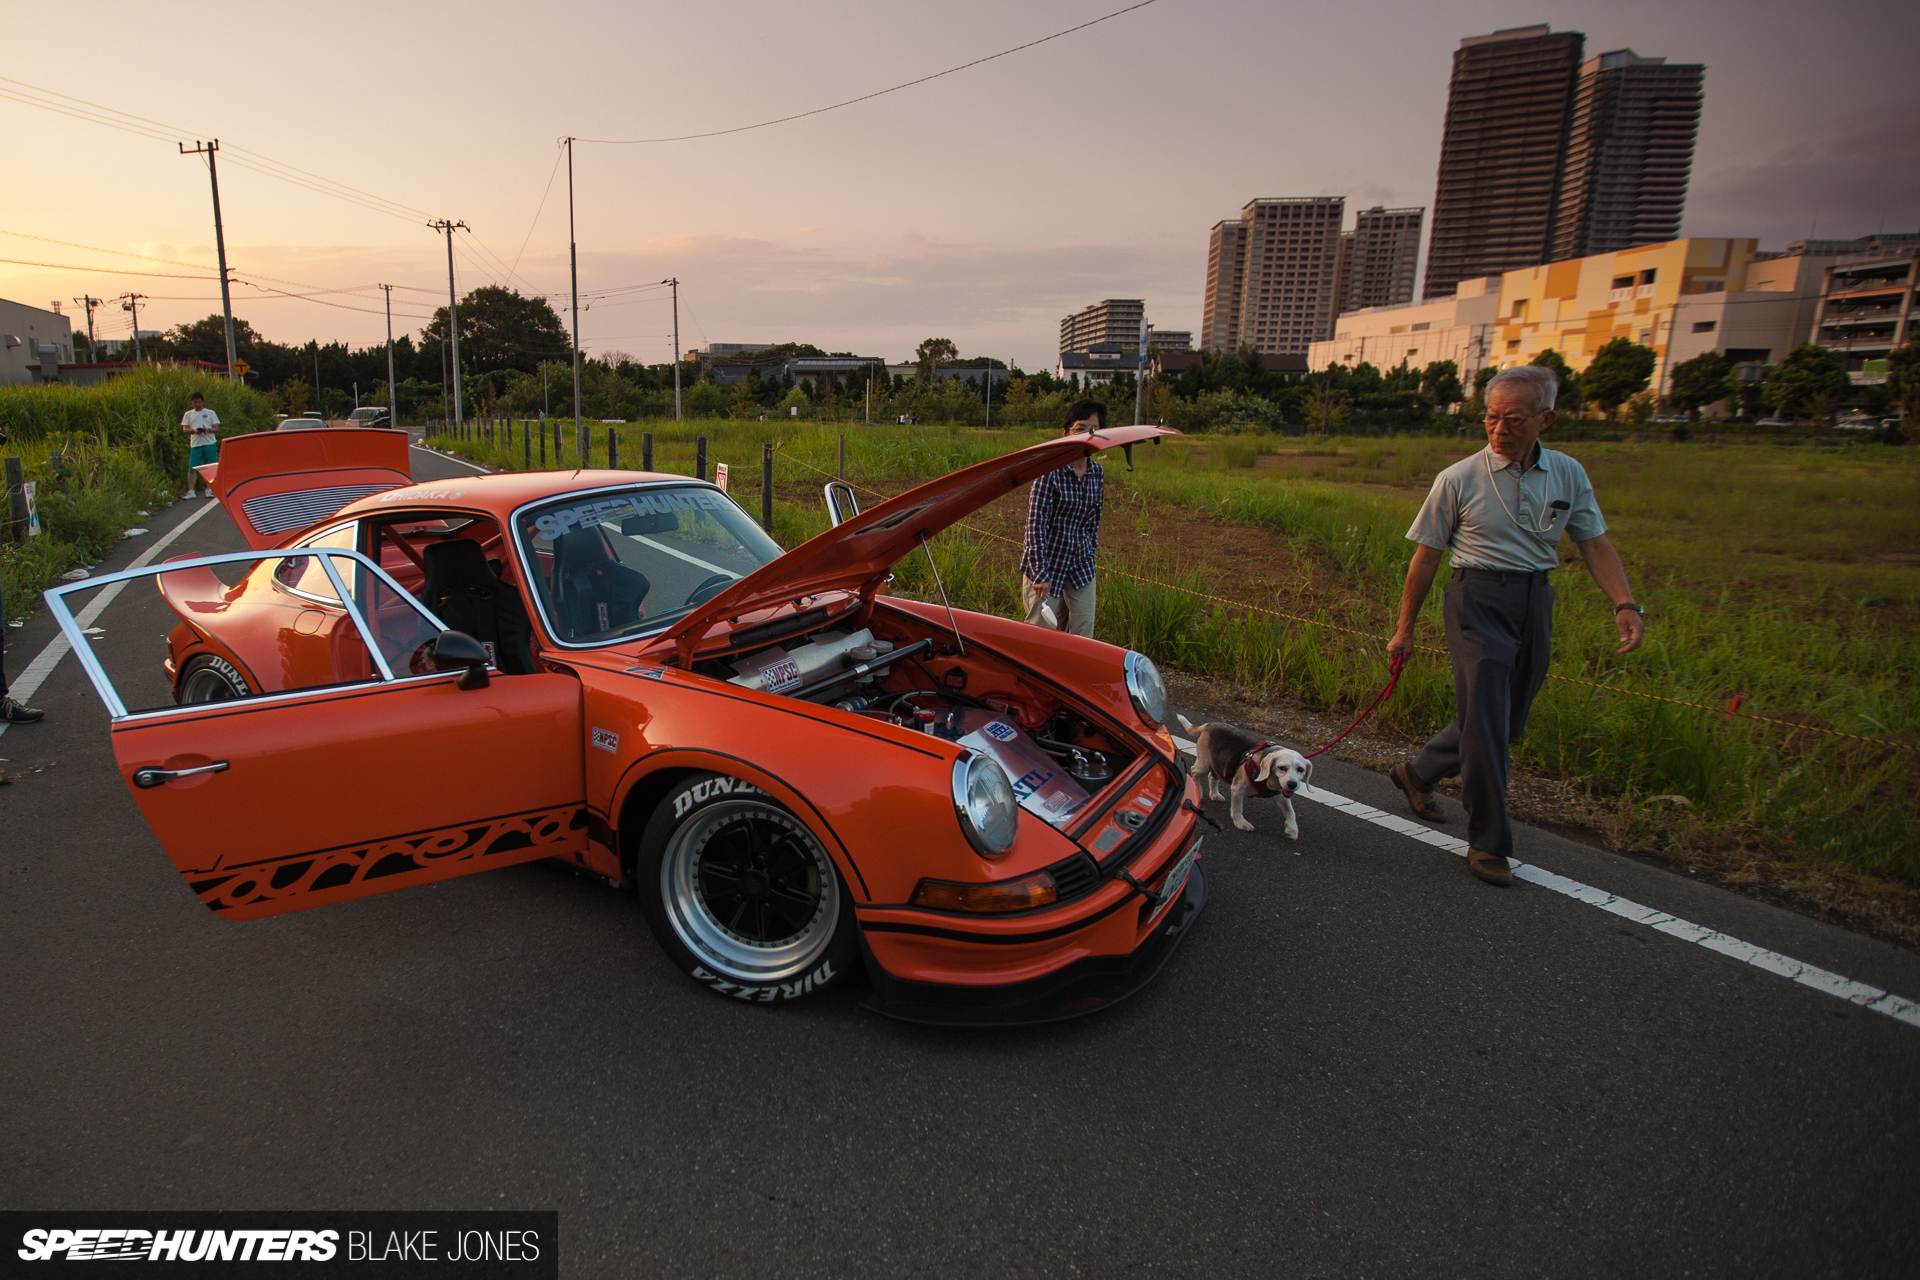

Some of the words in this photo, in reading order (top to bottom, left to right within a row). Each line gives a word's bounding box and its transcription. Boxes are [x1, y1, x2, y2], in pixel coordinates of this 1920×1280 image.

[393, 491, 450, 500] HIDAKA
[535, 493, 736, 541] SPEEDHUNTERS
[209, 655, 249, 696] DUNL
[771, 661, 799, 686] NPSC
[599, 731, 617, 748] NPSC
[673, 776, 771, 819] DUNL
[691, 959, 836, 1002] DIREZZA
